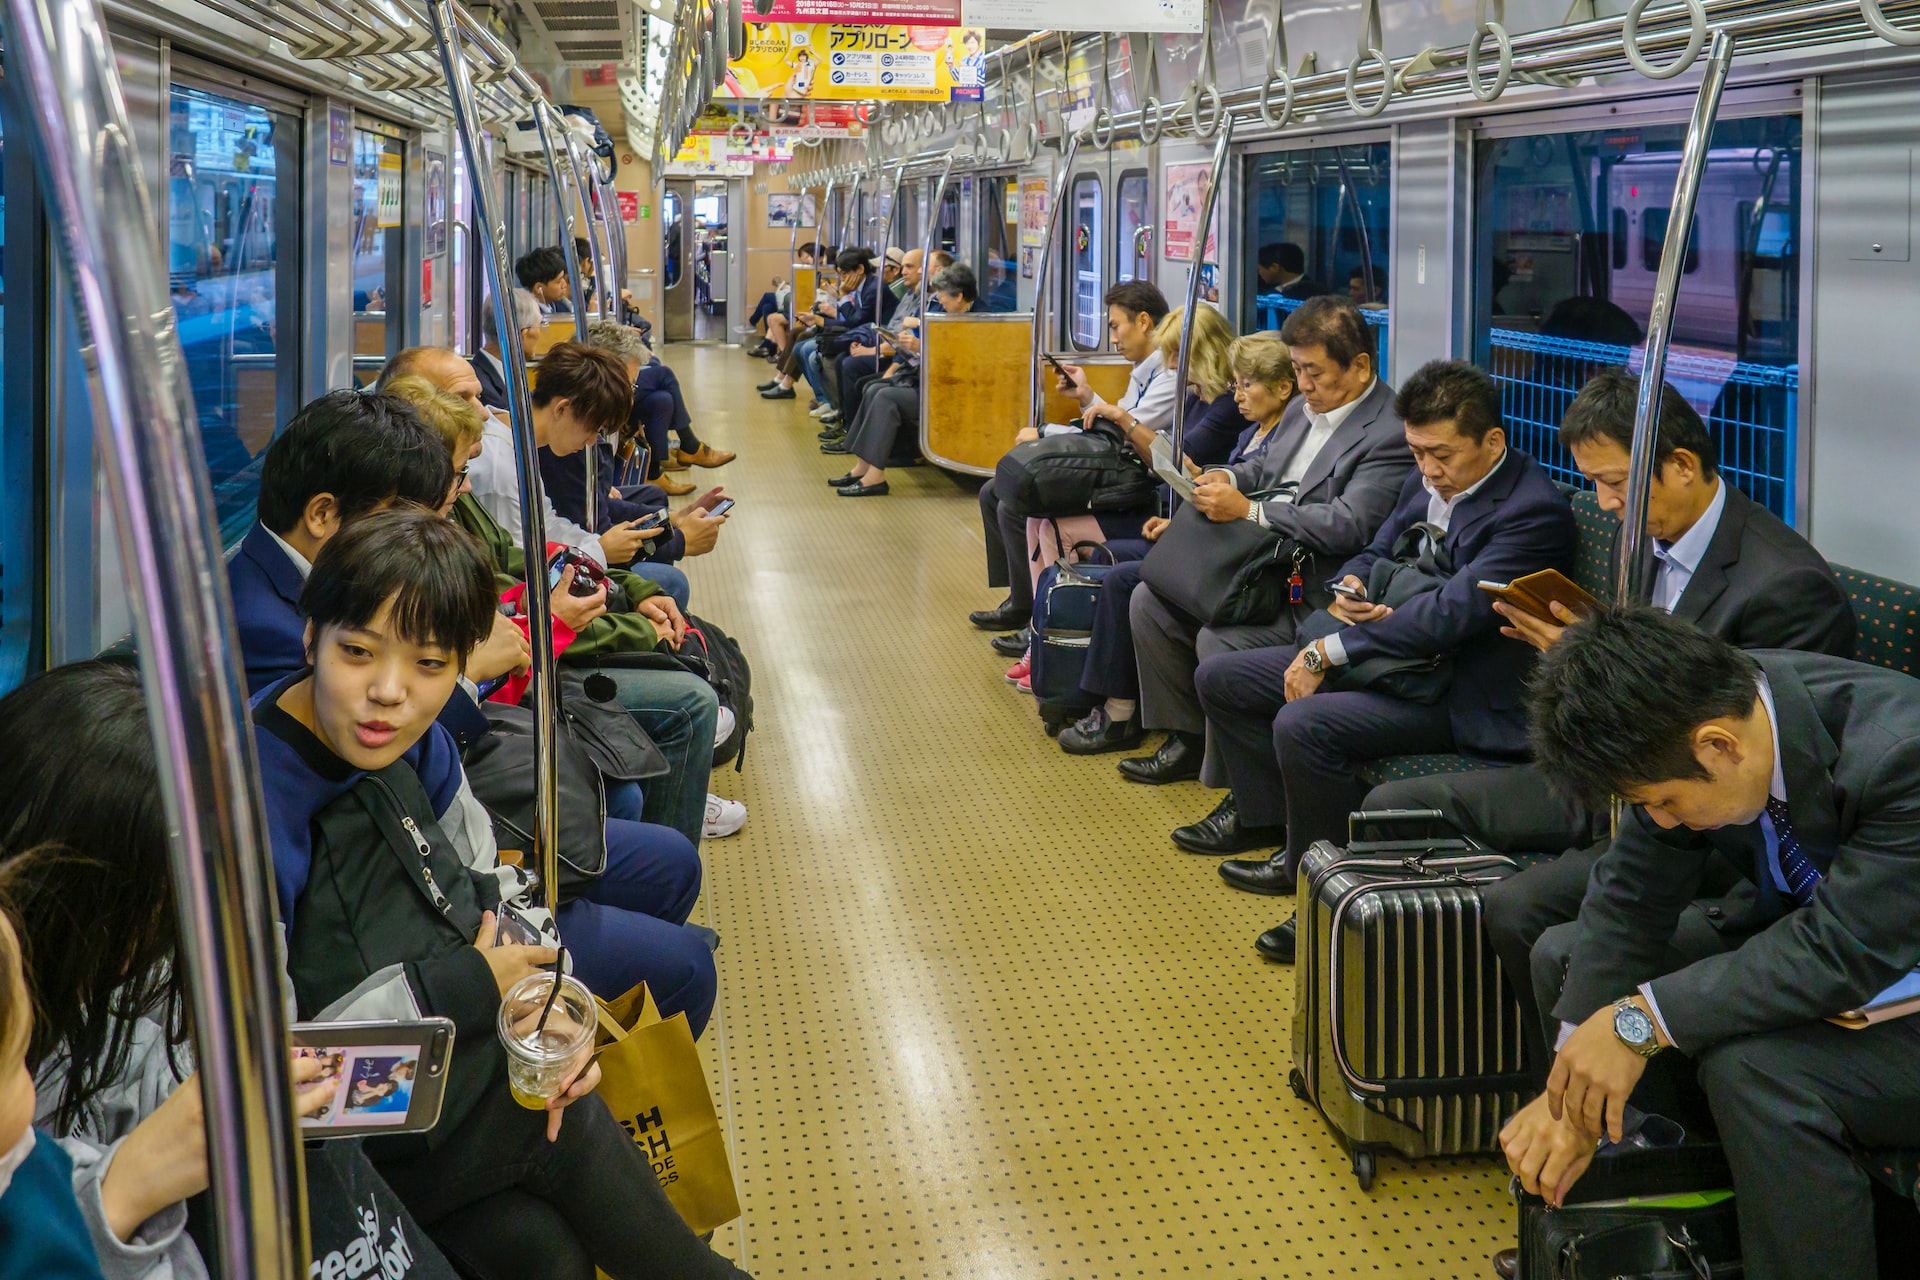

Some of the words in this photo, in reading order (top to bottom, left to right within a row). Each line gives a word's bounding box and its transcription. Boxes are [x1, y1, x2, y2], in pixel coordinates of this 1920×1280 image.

[830, 30, 912, 49] アプリローン
